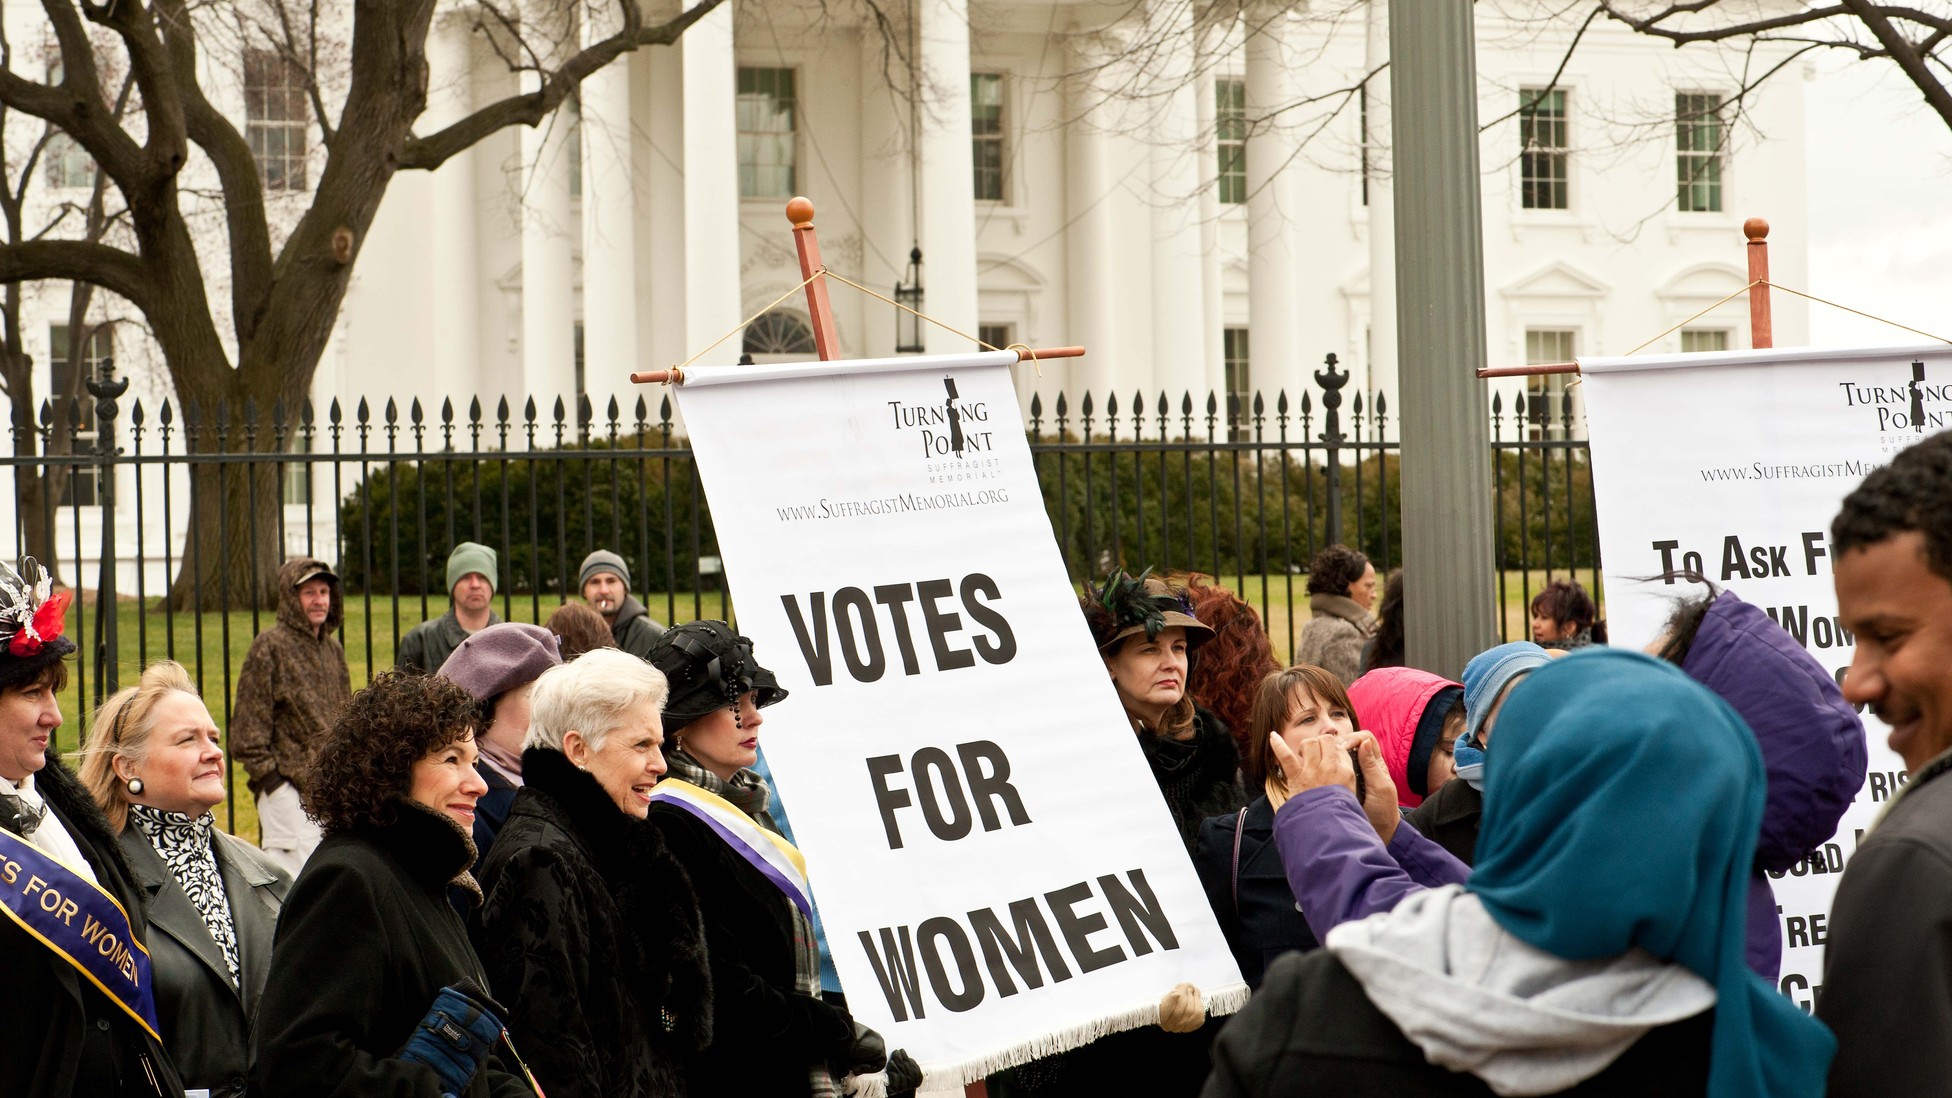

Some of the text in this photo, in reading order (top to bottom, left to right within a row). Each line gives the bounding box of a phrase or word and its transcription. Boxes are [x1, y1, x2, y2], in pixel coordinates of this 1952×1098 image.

[927, 459, 1000, 473] SUFFRAGIST
[1652, 539, 1704, 585] TO
[1720, 535, 1791, 581] ASK
[780, 573, 1018, 687] VOTES
[865, 740, 1033, 850] FOR
[22, 874, 79, 927] FOR
[80, 913, 139, 988] WOMEN
[857, 868, 1180, 1023] WOMEN
